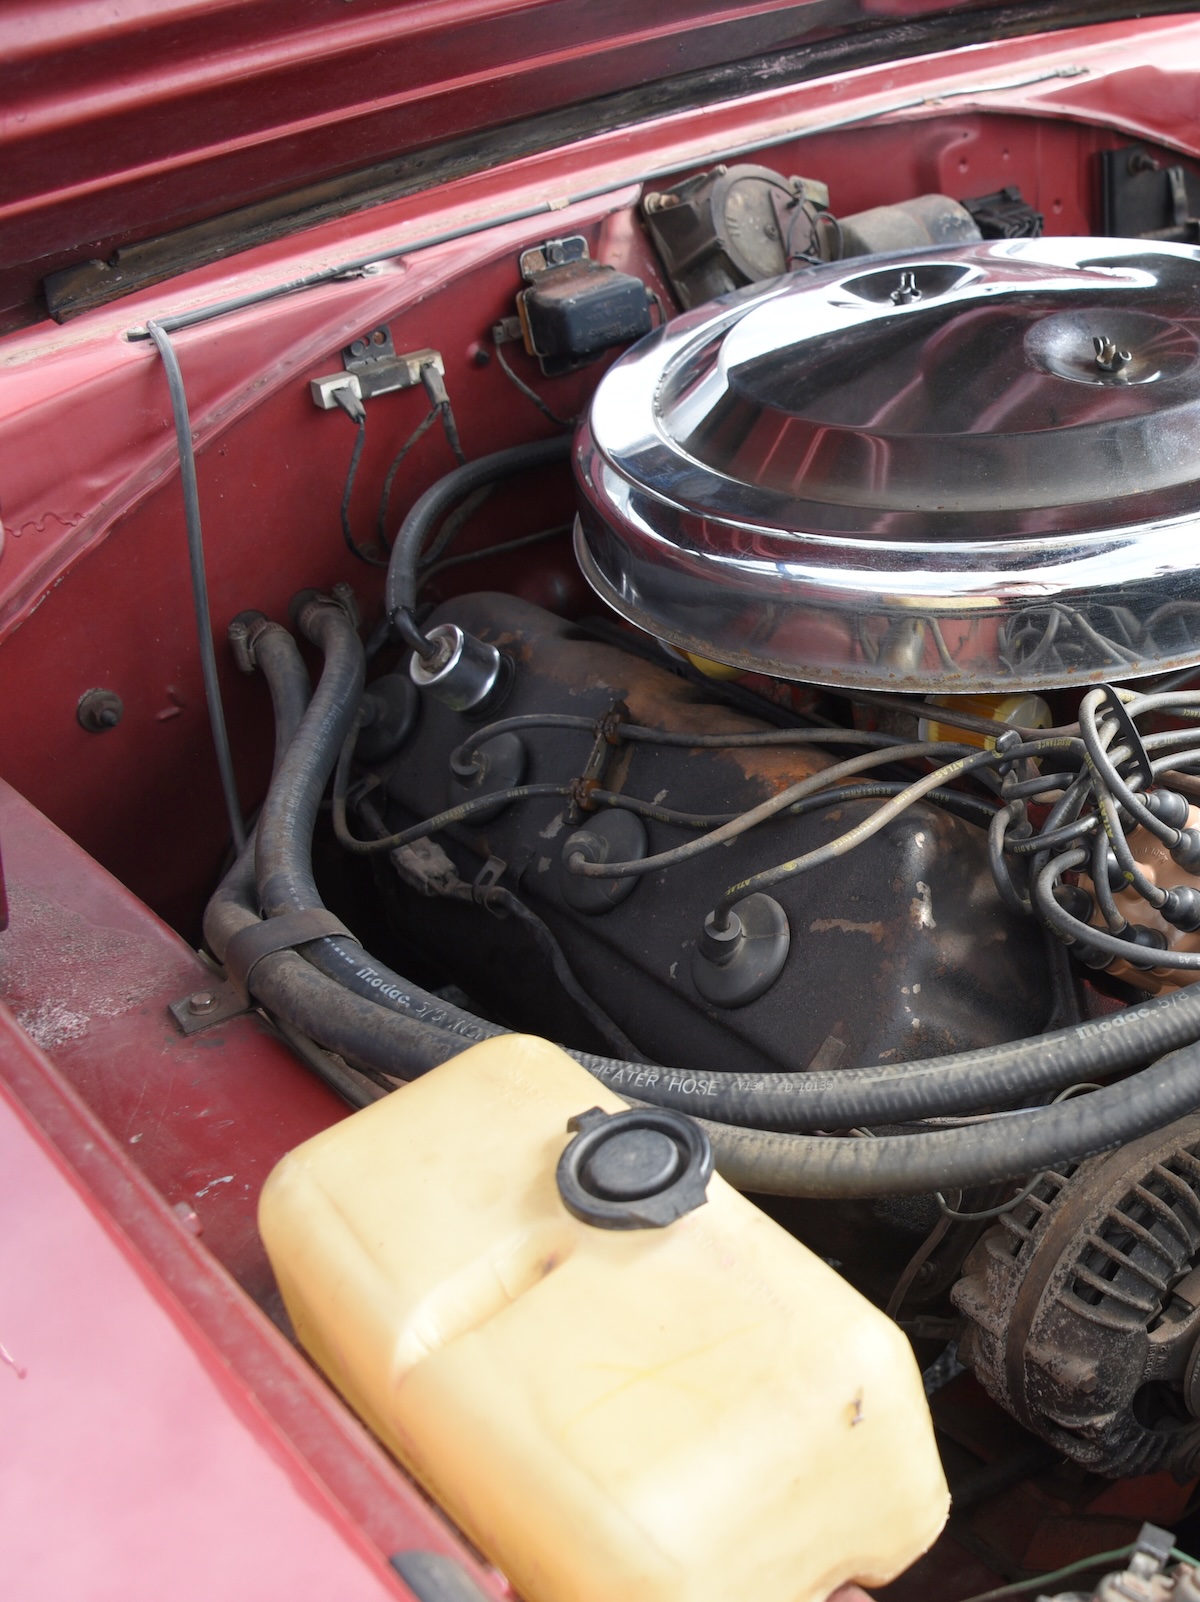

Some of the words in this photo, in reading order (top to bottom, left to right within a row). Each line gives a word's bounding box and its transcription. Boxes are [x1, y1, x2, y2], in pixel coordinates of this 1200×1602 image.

[840, 787, 892, 799] RESISTANCE
[926, 790, 950, 801] RADIO
[1014, 842, 1036, 853] RADIO
[1158, 991, 1190, 1009] 5/8
[668, 1077, 720, 1097] HOSE
